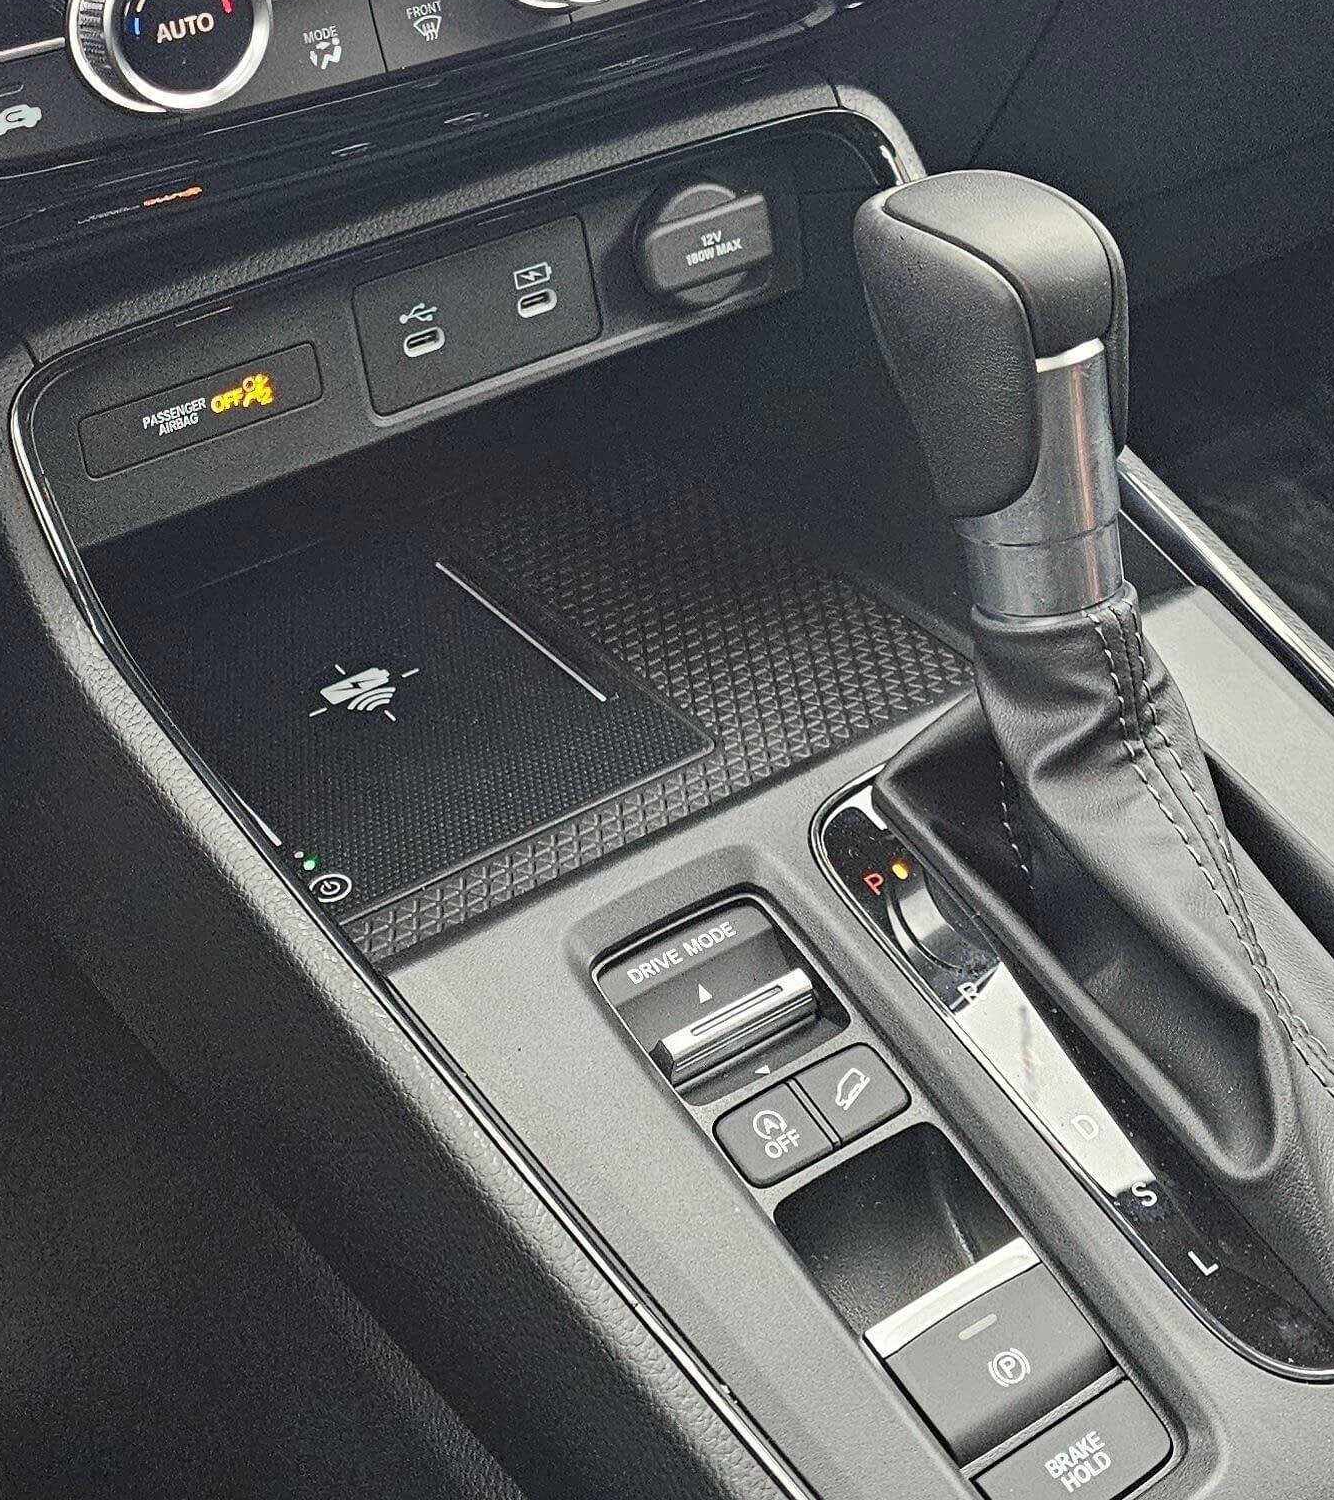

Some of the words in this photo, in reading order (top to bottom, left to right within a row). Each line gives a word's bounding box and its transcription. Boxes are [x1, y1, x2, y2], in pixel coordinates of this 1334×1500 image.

[405, 0, 443, 20] FRONT
[156, 12, 215, 44] AUTO
[302, 25, 339, 45] MODE
[685, 246, 716, 267] 180W
[715, 237, 744, 257] MAX
[700, 229, 722, 248] 12V
[142, 397, 207, 430] PASSENGER
[210, 386, 245, 414] OFF
[158, 411, 200, 437] AIRBAG
[863, 872, 885, 896] P
[626, 947, 685, 985] DRIVE
[683, 920, 737, 957] MODE
[1070, 1114, 1100, 1141] D
[764, 1128, 801, 1159] OFF
[1131, 1181, 1158, 1207] S
[1187, 1250, 1220, 1277] L
[1044, 1430, 1106, 1479] BRAKE
[1060, 1451, 1112, 1494] HOLD
